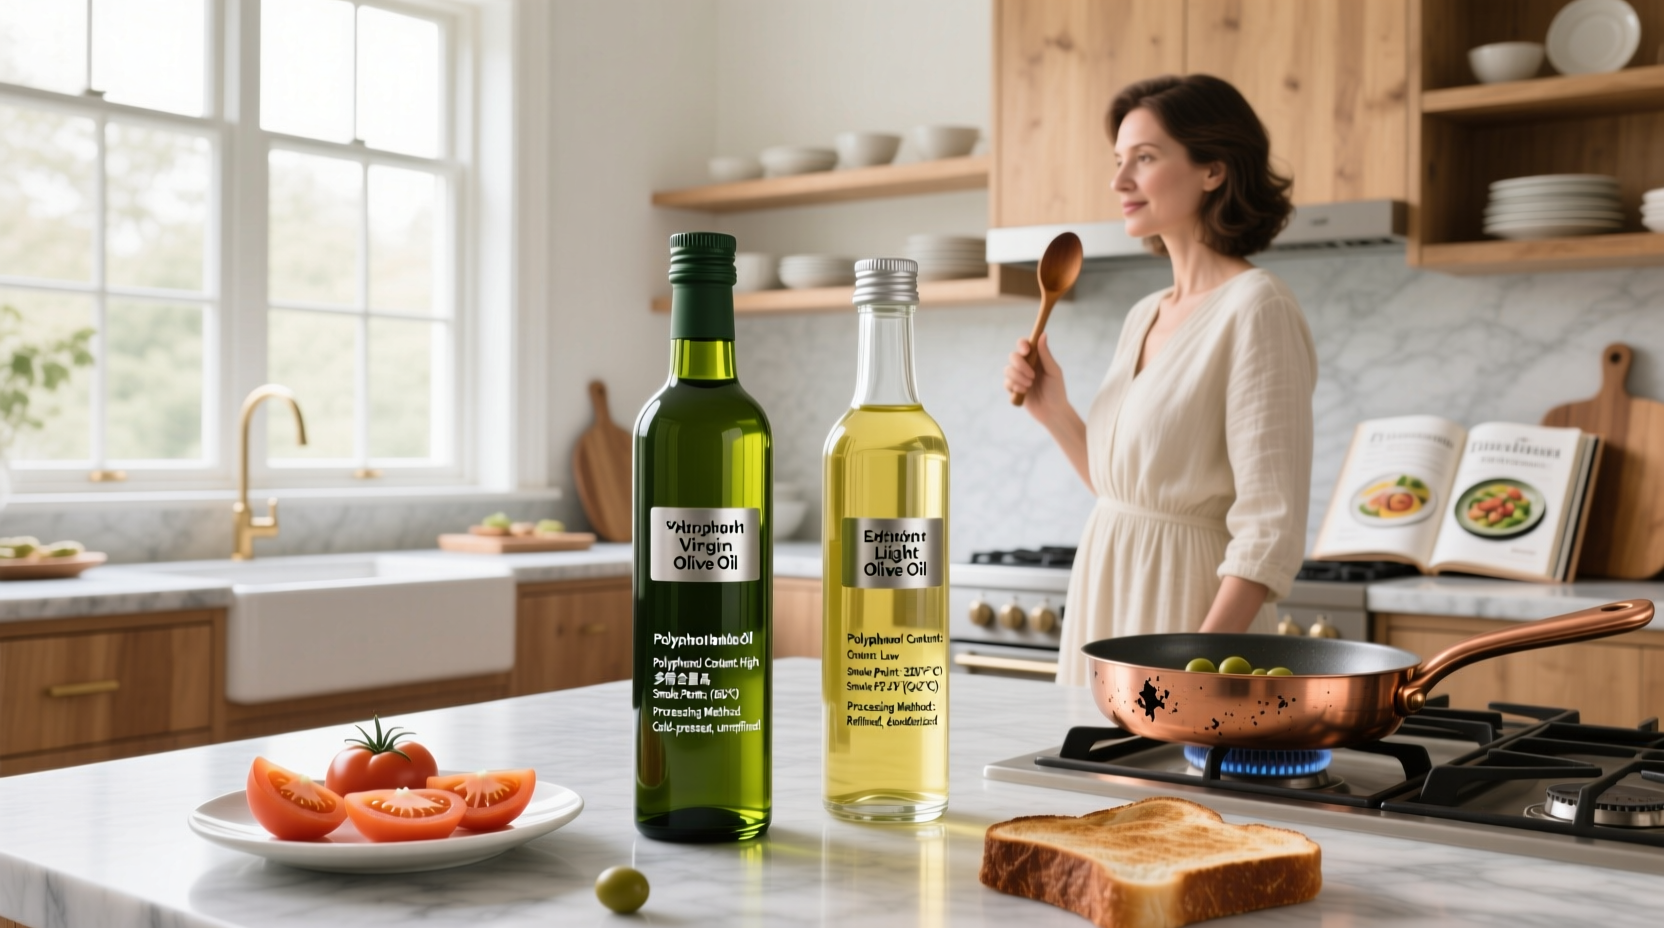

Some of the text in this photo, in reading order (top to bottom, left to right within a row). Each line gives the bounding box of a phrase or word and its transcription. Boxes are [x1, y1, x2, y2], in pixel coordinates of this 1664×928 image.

[679, 537, 733, 556] Virgin
[673, 554, 738, 570] Olive Oil
[864, 561, 927, 577] Olive Oil
